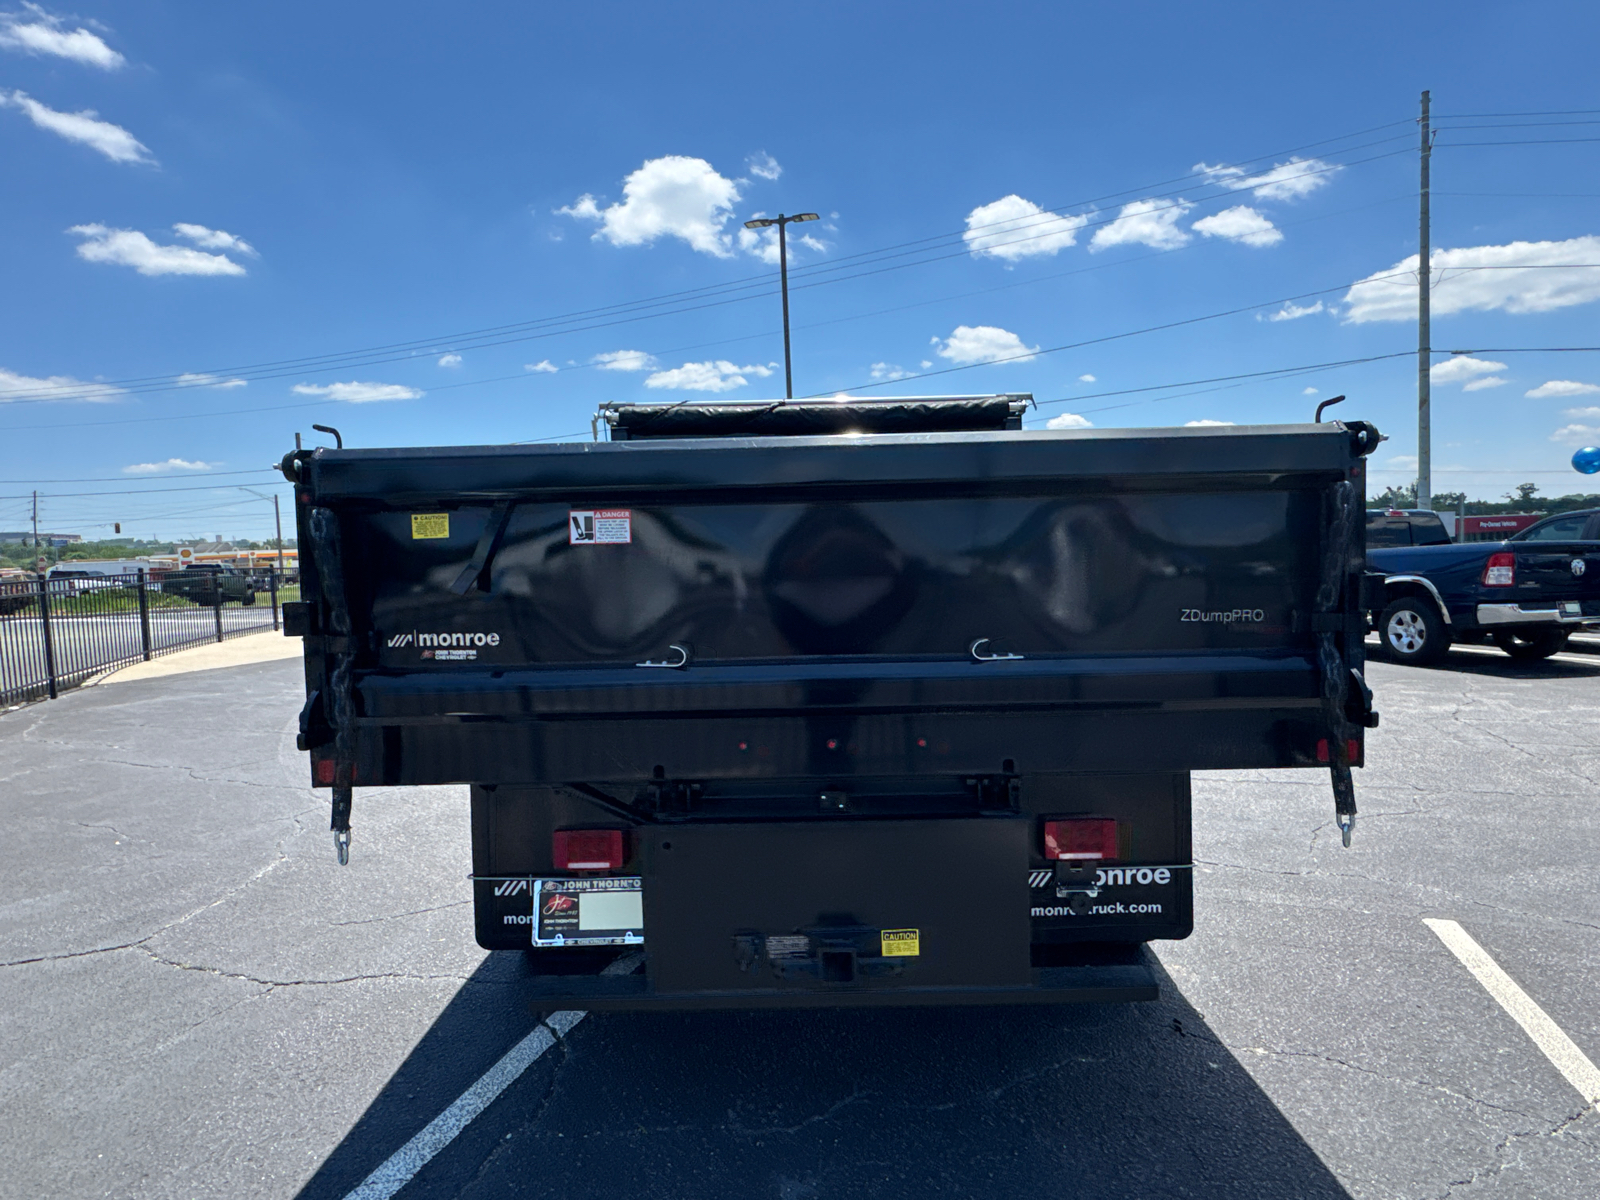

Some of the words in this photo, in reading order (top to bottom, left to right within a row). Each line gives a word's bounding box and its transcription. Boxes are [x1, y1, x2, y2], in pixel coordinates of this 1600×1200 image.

[1181, 609, 1264, 624] ZDumpPRO
[419, 632, 500, 647] monroe
[563, 880, 590, 890] JOHN
[592, 879, 641, 889] THORNTO
[1096, 868, 1171, 886] onroe
[884, 932, 916, 941] CAUTION
